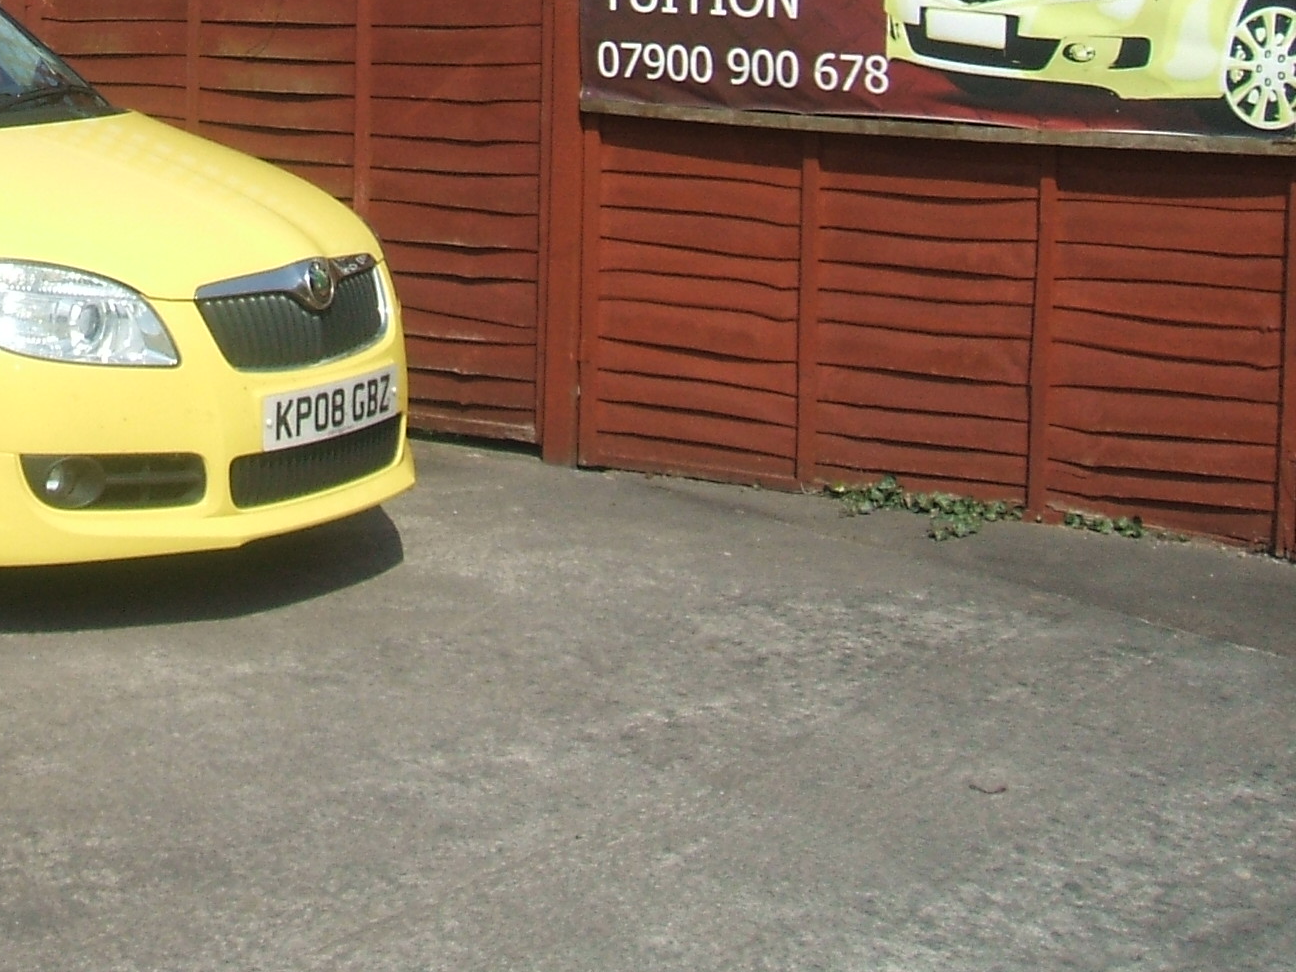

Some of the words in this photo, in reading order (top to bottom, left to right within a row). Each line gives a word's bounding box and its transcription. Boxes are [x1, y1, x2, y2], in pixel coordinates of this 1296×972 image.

[597, 41, 713, 83] 07900
[727, 48, 799, 88] 900
[813, 52, 890, 94] 678
[276, 388, 345, 440] KP08
[352, 374, 391, 421] GBZ
